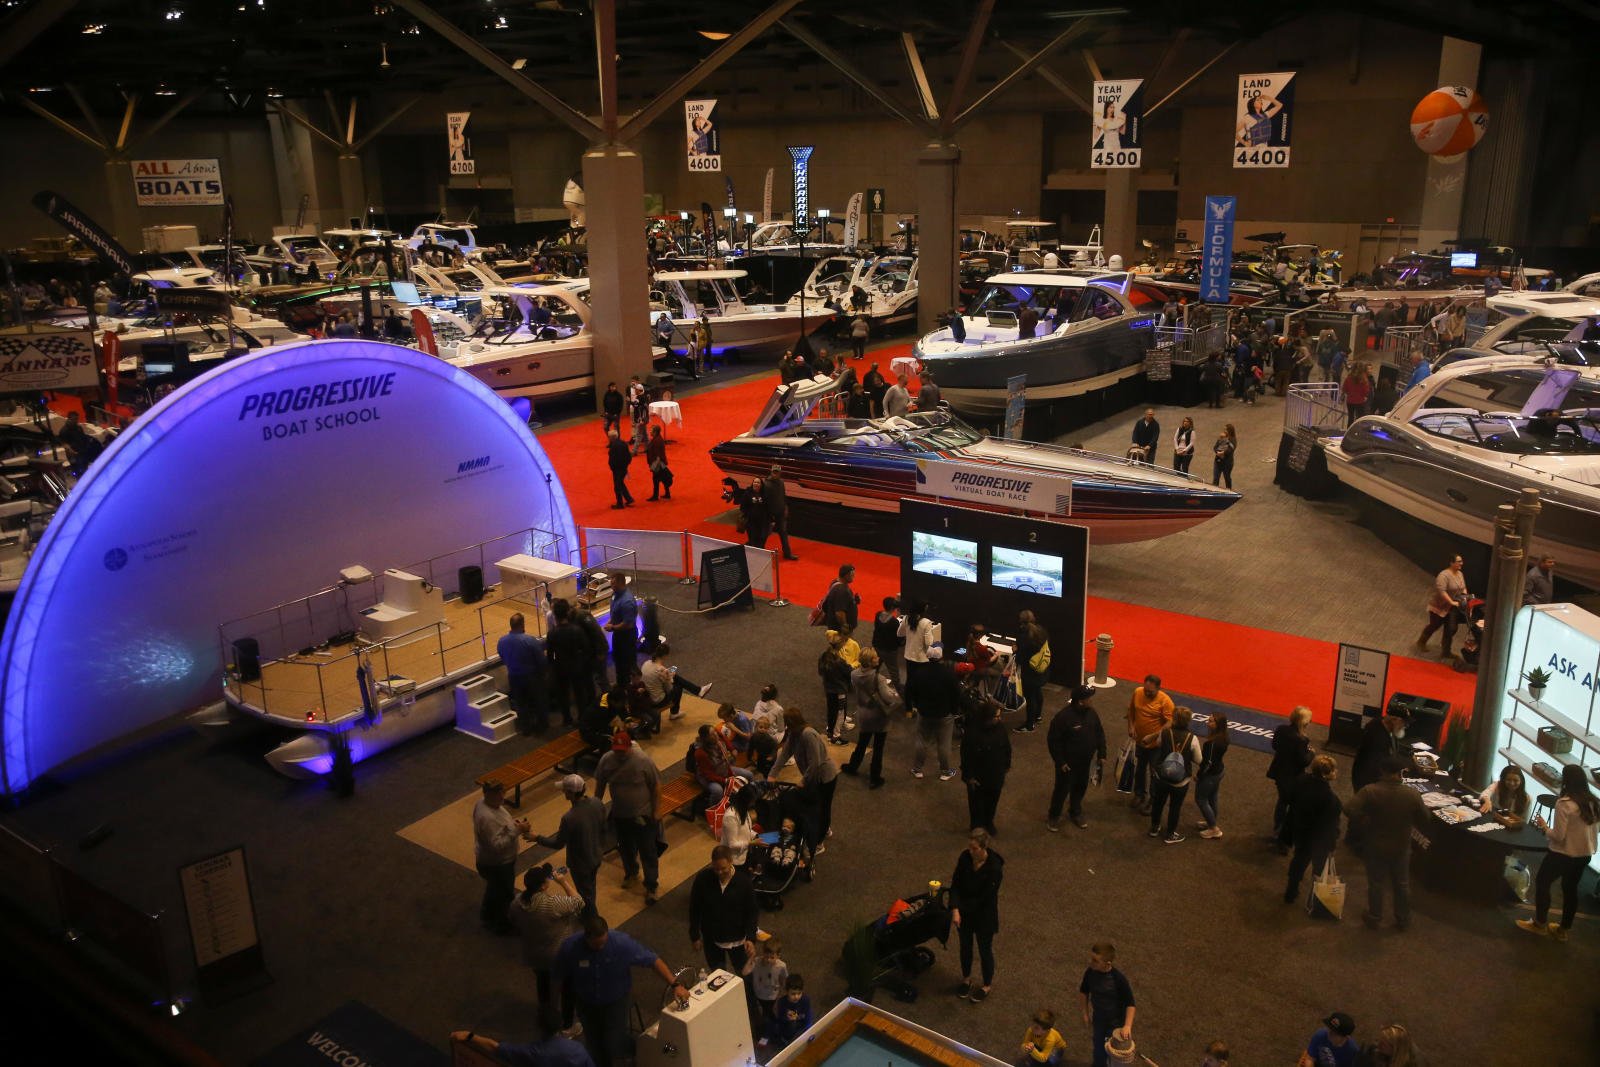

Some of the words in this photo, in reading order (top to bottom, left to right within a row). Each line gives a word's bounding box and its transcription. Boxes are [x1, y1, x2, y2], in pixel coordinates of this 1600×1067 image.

[1098, 86, 1122, 94] YEAH
[1243, 80, 1271, 88] LAND
[1098, 95, 1120, 104] BUOY
[1243, 90, 1262, 99] FLO
[690, 158, 718, 169] 4600
[1095, 152, 1137, 165] 4500
[1237, 150, 1285, 164] 4400
[137, 162, 174, 175] ALL
[178, 162, 217, 174] About
[452, 163, 472, 172] 4700
[138, 181, 221, 195] BOATS
[796, 162, 806, 224] CHAPARRAL
[1208, 224, 1225, 298] FORMULA
[238, 372, 396, 421] PROGRESSIVE
[263, 420, 308, 441] BOAT
[316, 407, 382, 431] SCHOOL
[952, 472, 1033, 494] PROGRESSIVE
[954, 485, 983, 495] VIRTUAL
[986, 489, 1006, 498] BOAT
[1009, 492, 1027, 501] RACE
[943, 517, 949, 528] 1
[1029, 531, 1037, 543] 2
[1548, 653, 1577, 680] ASK
